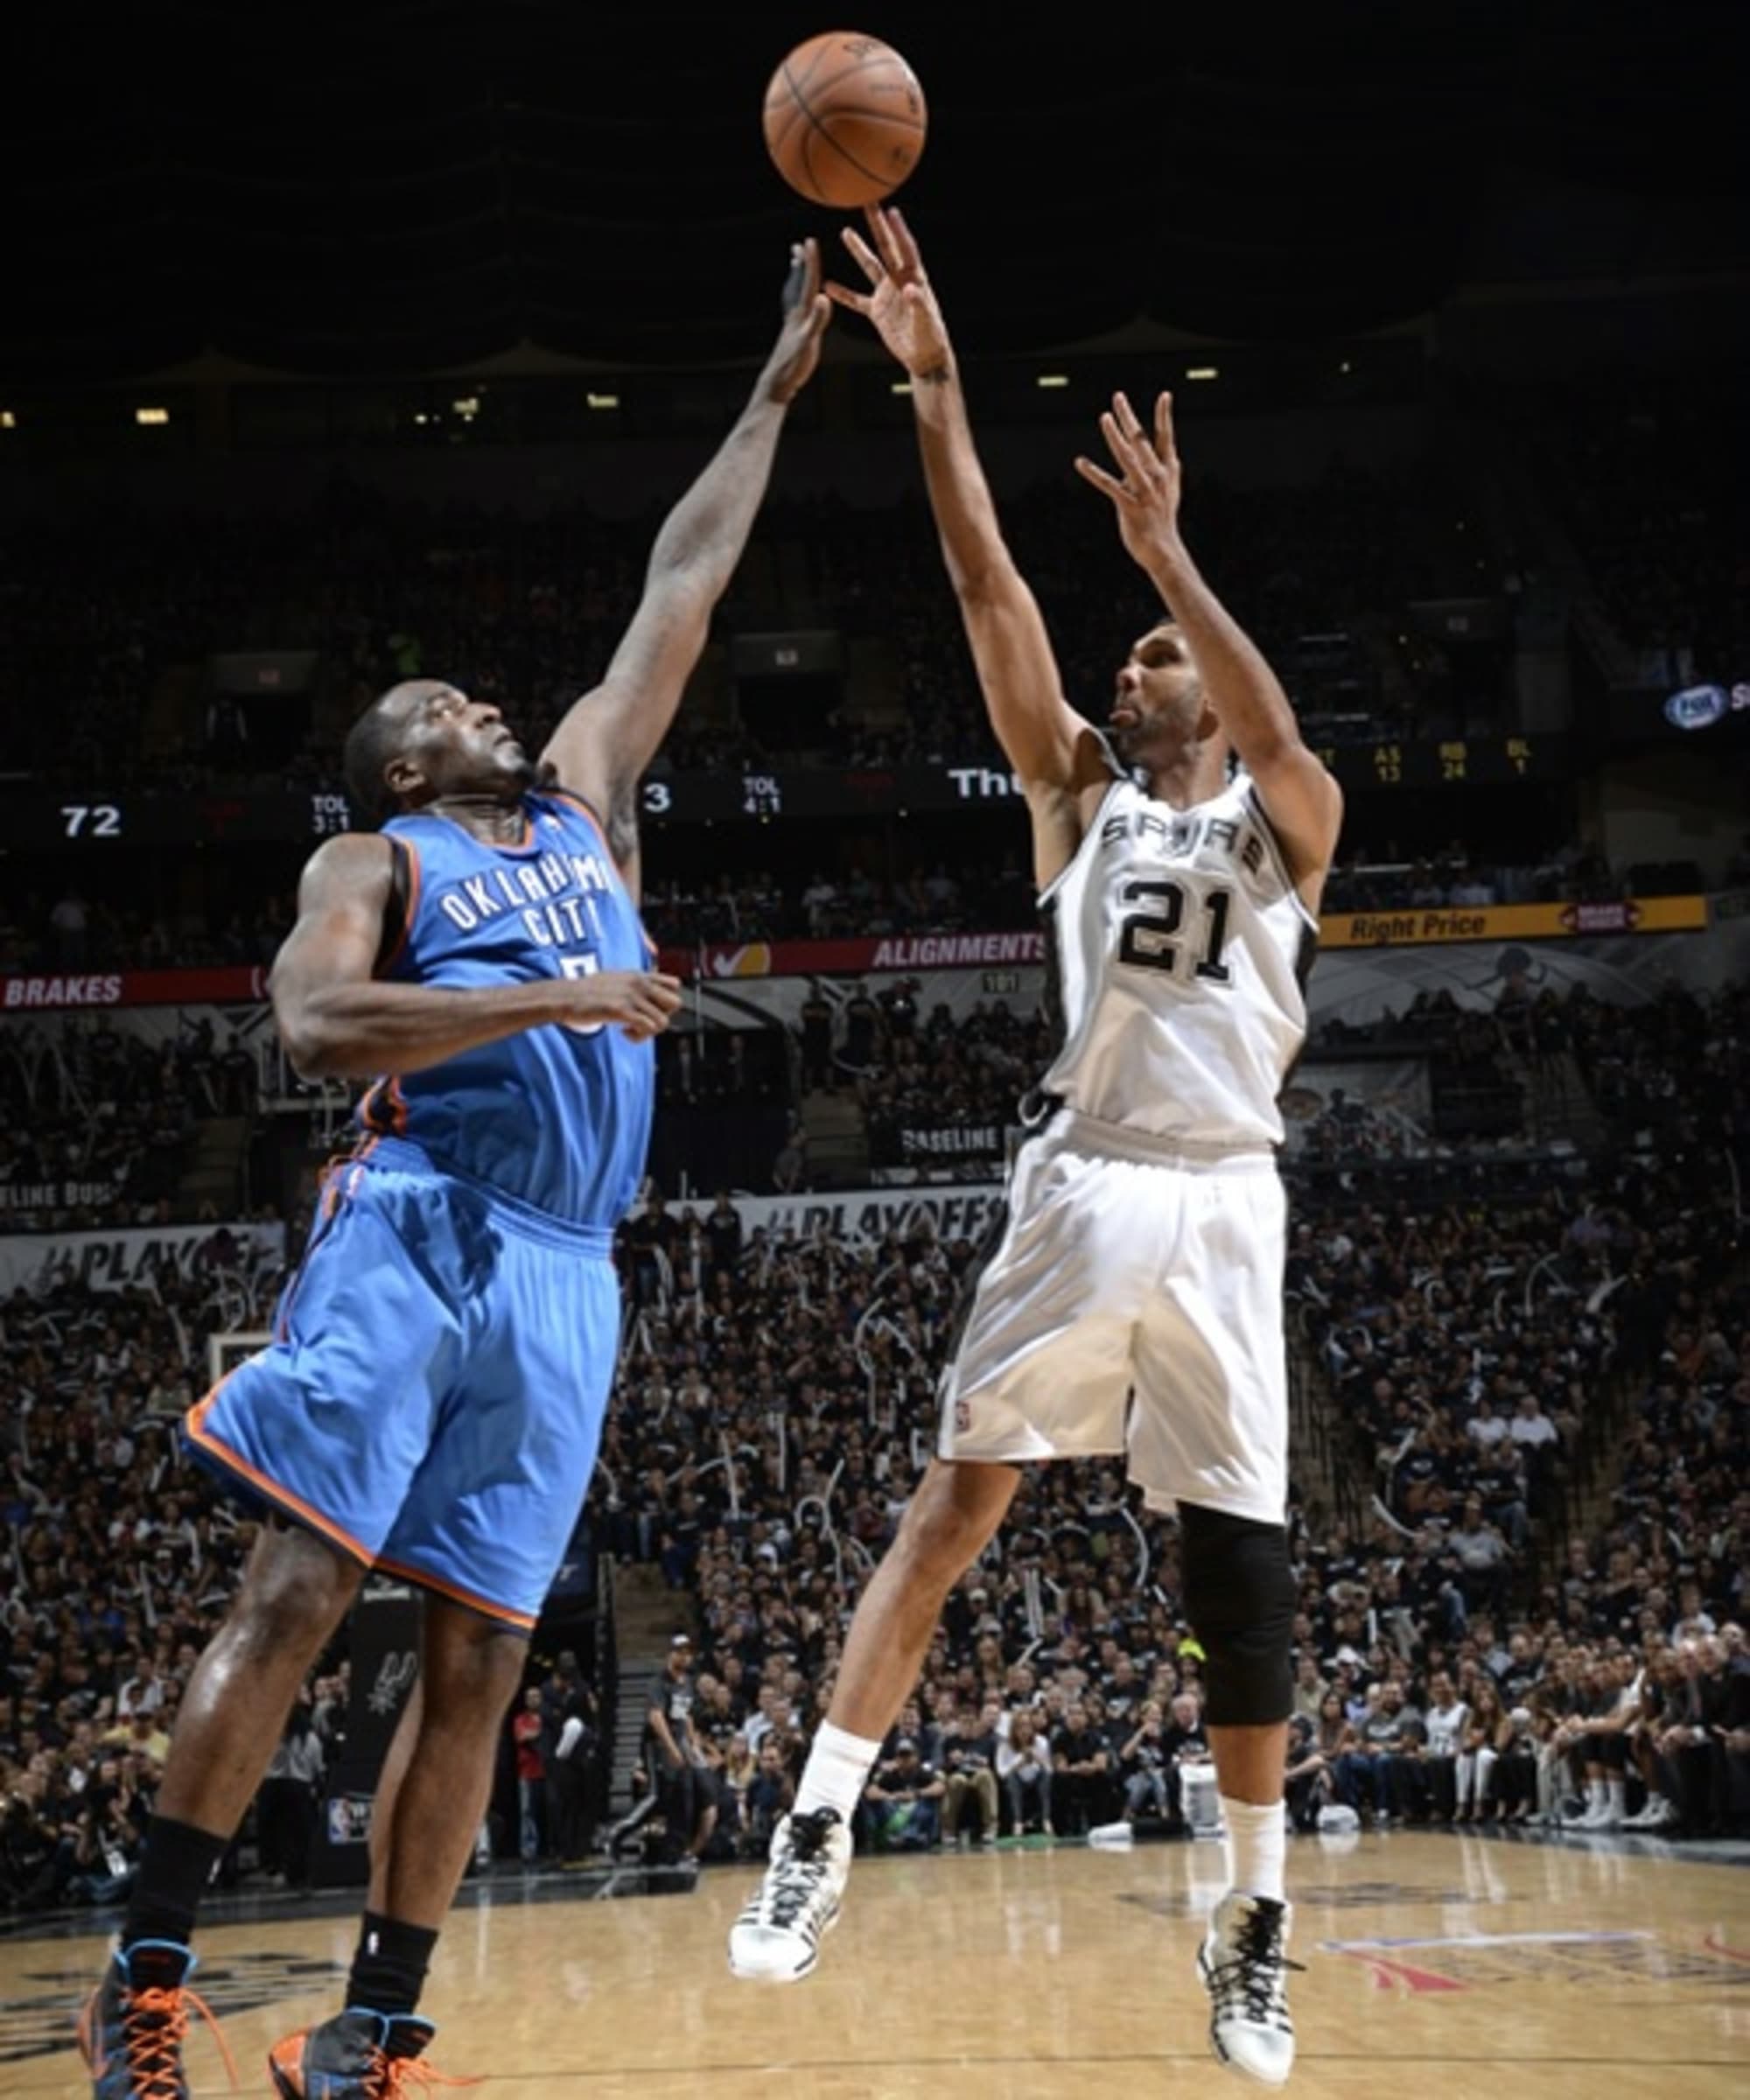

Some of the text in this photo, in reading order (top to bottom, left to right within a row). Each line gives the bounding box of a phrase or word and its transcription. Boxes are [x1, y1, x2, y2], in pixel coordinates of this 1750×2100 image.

[1732, 682, 1750, 710] S
[743, 776, 781, 795] TOL
[60, 804, 123, 839] 72
[312, 794, 350, 814] TOL
[1100, 811, 1265, 877] SPURS
[440, 851, 611, 932] OKLAHM
[1116, 878, 1232, 983] 21
[1350, 911, 1487, 946] Right Price
[4, 974, 123, 1007] BRAKES
